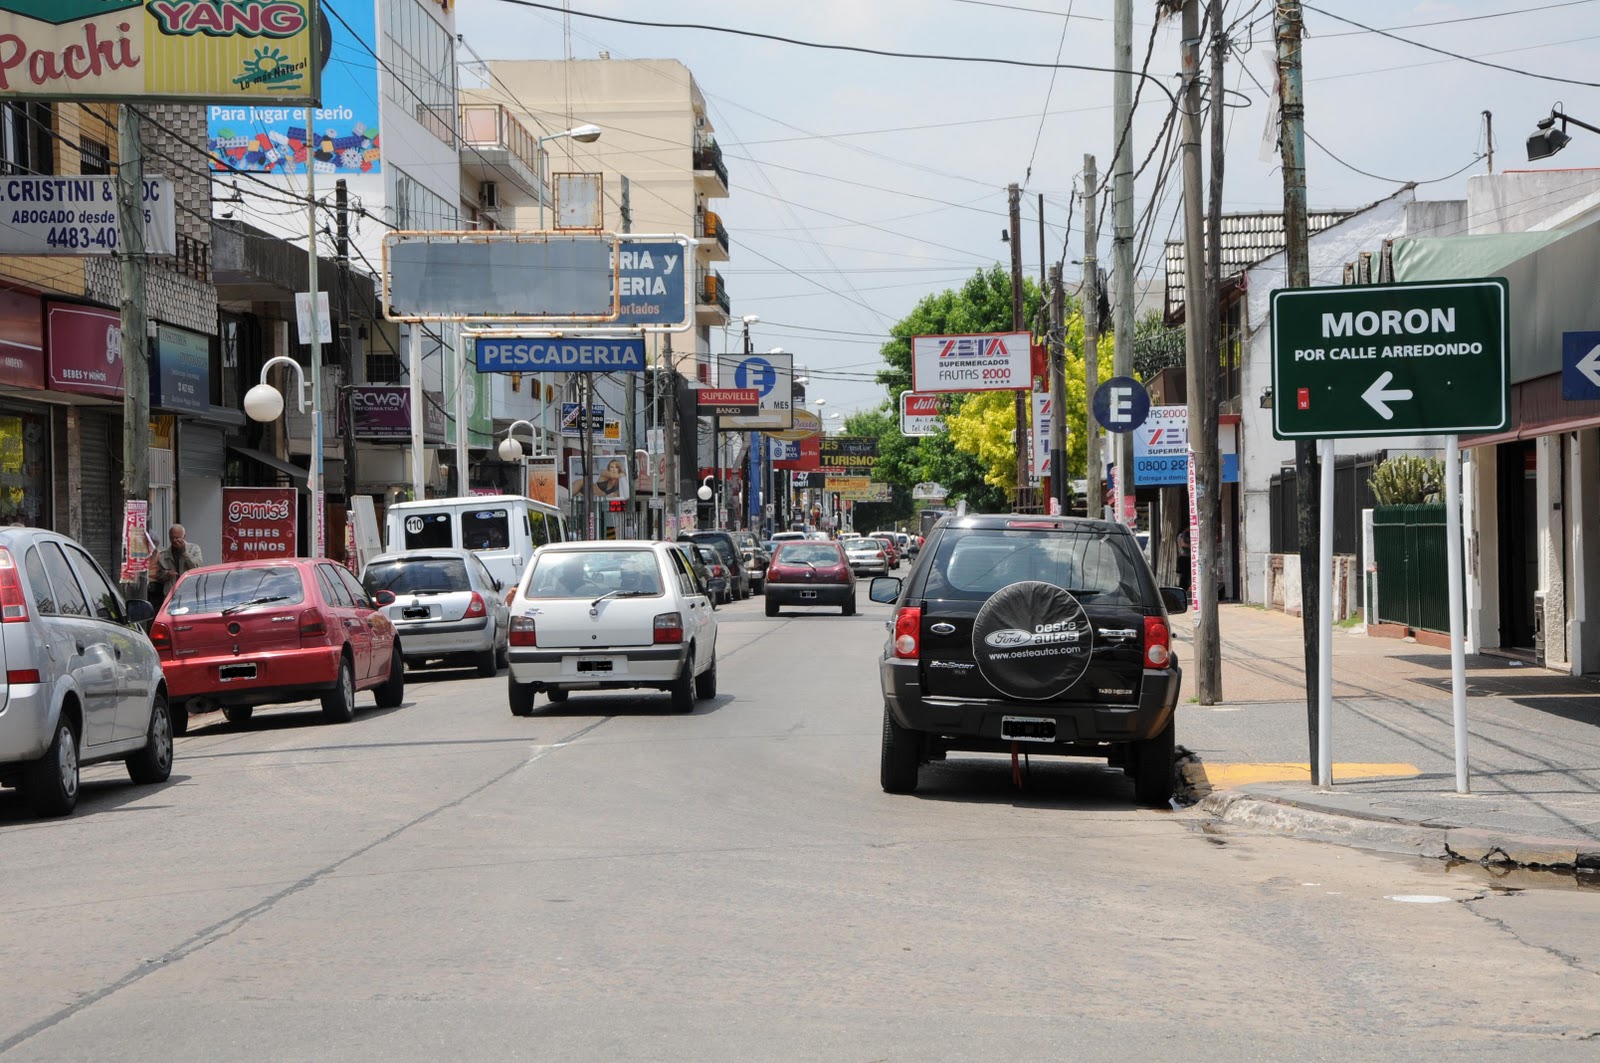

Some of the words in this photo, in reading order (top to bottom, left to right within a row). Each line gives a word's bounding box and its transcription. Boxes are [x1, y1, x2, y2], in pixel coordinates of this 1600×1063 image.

[155, 1, 304, 33] YANG
[211, 106, 246, 121] Para
[250, 106, 289, 125] jugar
[315, 105, 353, 121] serio
[7, 180, 95, 202] CRISTINI
[102, 181, 113, 202] &
[12, 210, 75, 224] ABOGADO
[79, 210, 115, 224] desde
[663, 254, 679, 275] y
[1321, 307, 1456, 338] MORON
[938, 338, 1011, 358] ZETA
[1294, 349, 1326, 362] POR
[1329, 346, 1377, 360] CALLE
[1381, 341, 1483, 359] ARREDONDO
[484, 345, 639, 365] PESCADERIA
[938, 359, 1010, 368] SUPERMERCADOS
[62, 369, 82, 379] BEBES
[939, 369, 980, 381] FRUTAS
[982, 368, 1011, 379] 2000
[701, 391, 756, 401] SUPERVIELLE
[773, 401, 790, 410] MES
[1109, 387, 1132, 423] E
[1163, 409, 1187, 418] 2000
[823, 455, 874, 466] TURISMO
[1138, 460, 1168, 471] 0800
[229, 500, 289, 522] gamisé
[407, 519, 423, 531] 110
[238, 528, 280, 538] BEBES
[230, 542, 239, 551] &
[243, 541, 286, 551] NIÑOS
[1034, 621, 1077, 634] oeste
[993, 632, 1022, 645] Ford
[1034, 632, 1076, 645] autos
[988, 646, 1081, 661] www.oesteautos.com
